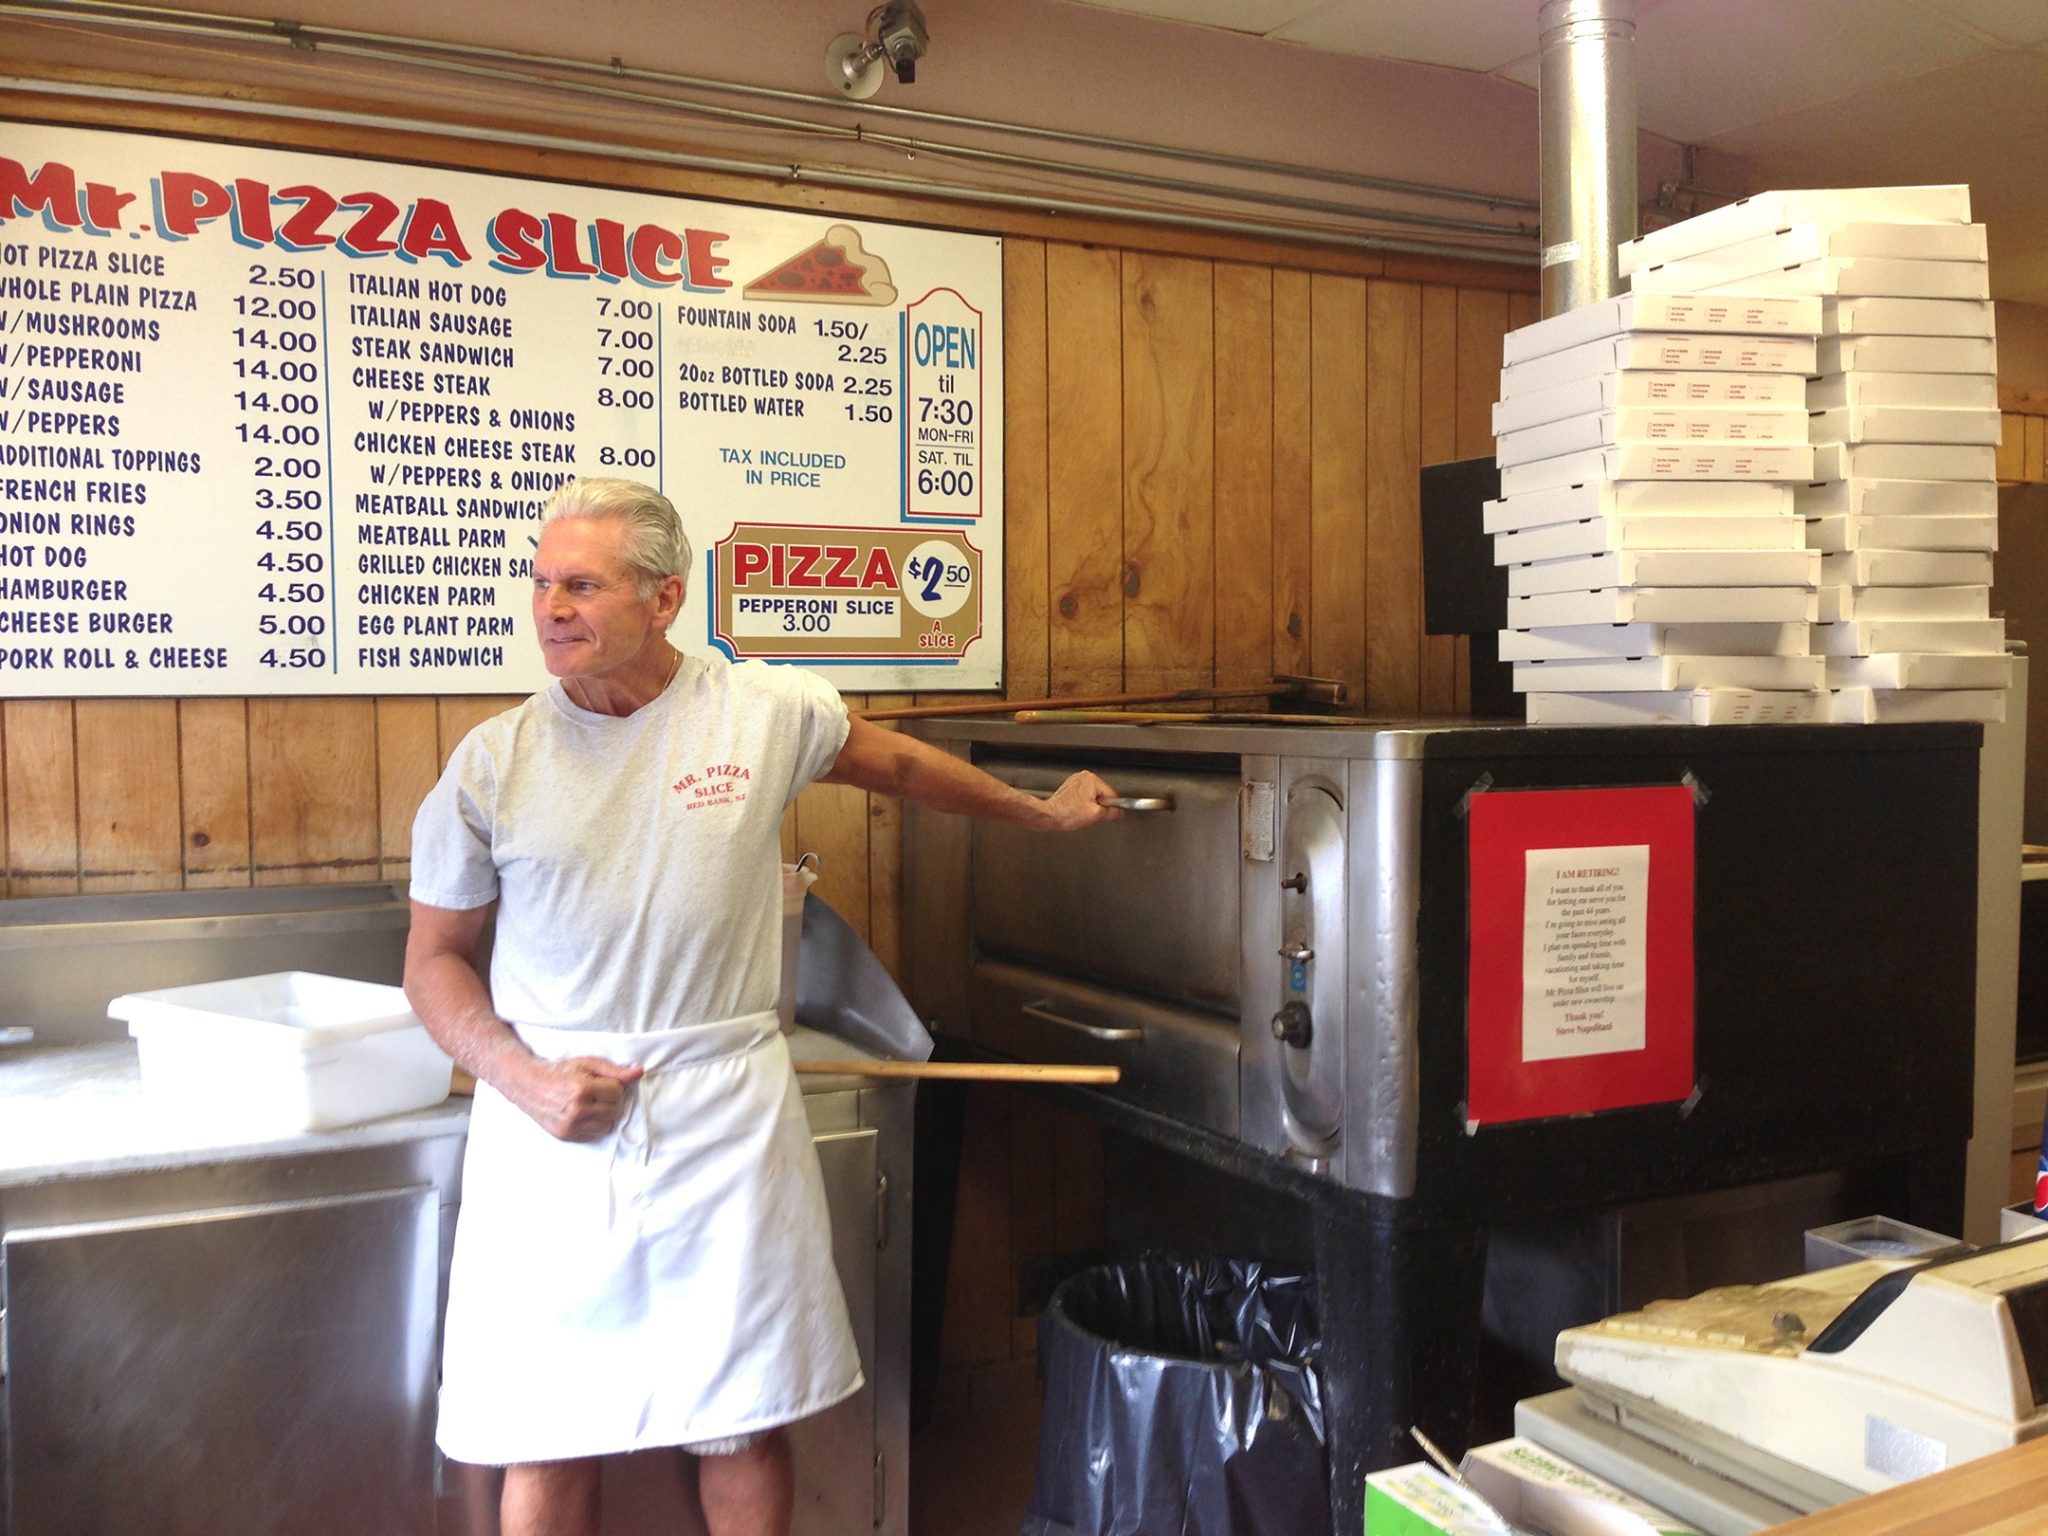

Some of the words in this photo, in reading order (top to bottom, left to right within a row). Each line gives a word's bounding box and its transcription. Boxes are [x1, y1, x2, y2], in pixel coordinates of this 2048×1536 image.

[0, 157, 151, 236] Mr.
[150, 172, 471, 268] PIZZA
[486, 207, 733, 294] SLICE
[0, 242, 30, 266] OT
[38, 246, 98, 272] PIZZA
[108, 252, 164, 276] SLICE
[248, 264, 316, 290] 2.50
[72, 282, 128, 308] PLAIN
[140, 286, 198, 312] PIZZA
[234, 296, 316, 320] 12.00
[350, 272, 420, 300] ITALIAN
[428, 280, 462, 304] HOT
[472, 284, 506, 308] DOG
[596, 298, 652, 320] 7.00
[350, 304, 420, 330] ITALIAN
[430, 312, 512, 338] SAUSAGE
[596, 328, 654, 350] 7.00
[678, 306, 750, 330] FOUNTAIN
[758, 314, 796, 334] SODA
[232, 328, 316, 352] 14.00
[914, 322, 974, 370] OPEN
[352, 336, 412, 360] STEAK
[420, 342, 514, 368] SANDWICH
[598, 356, 654, 378] 7.00
[838, 344, 888, 364] 2.25
[232, 358, 318, 382] 14.00
[680, 362, 714, 384] 20oz
[722, 366, 788, 388] BOTTLED
[794, 372, 834, 392] SODA
[844, 376, 892, 396] 2.25
[352, 366, 424, 392] CHEESE
[434, 372, 490, 396] STEAK
[598, 388, 654, 410] 8.00
[938, 374, 954, 394] til
[234, 390, 318, 414] 14.00
[680, 390, 748, 414] BOTTLED
[754, 396, 804, 418] WATER
[844, 404, 892, 424] 1.50
[918, 396, 974, 426] 7:30
[368, 400, 480, 426] W/PEPPERS
[488, 408, 502, 428] &
[510, 408, 574, 432] ONIONS
[234, 422, 320, 446] 14.00
[918, 428, 974, 444] MON-FRI
[354, 432, 436, 456] CHICKEN
[444, 436, 512, 460] CHEESE
[522, 442, 576, 464] STEAK
[600, 446, 656, 468] 8.00
[720, 448, 752, 464] TAX
[760, 450, 846, 468] INCLUDED
[918, 450, 947, 466] SAT.
[952, 452, 974, 466] TIL
[112, 448, 200, 474] TOPPINGS
[254, 456, 320, 478] 2.00
[370, 464, 482, 488] W/PEPPERS
[490, 470, 502, 490] &
[746, 470, 762, 484] IN
[770, 470, 820, 488] PRICE
[918, 468, 974, 496] 6:00
[0, 478, 76, 502] RENCH
[86, 482, 146, 504] FRIES
[256, 488, 322, 510] 3.50
[356, 492, 448, 516] MEATBALL
[70, 514, 134, 536] RINGS
[256, 520, 322, 542] 4.50
[358, 524, 450, 548] MEATBALL
[458, 528, 506, 548] PARM
[44, 546, 86, 568] DOG
[256, 552, 324, 572] 4.50
[358, 554, 426, 576] GRILLED
[432, 556, 502, 578] CHICKEN
[734, 544, 898, 590] PIZZA
[258, 582, 324, 602] 4.50
[358, 584, 438, 606] CHICKEN
[448, 586, 496, 606] PARM
[740, 598, 838, 614] PEPPERONI
[846, 600, 894, 614] SLICE
[0, 610, 78, 634] CHEESE
[88, 612, 172, 634] BURGER
[258, 614, 326, 636] 5.00
[358, 614, 394, 636] EGG
[404, 616, 460, 636] PLANT
[466, 616, 514, 636] PARM
[782, 614, 830, 632] 3.00
[933, 620, 941, 633] A
[920, 634, 954, 648] SLICE
[64, 648, 116, 670] ROLL
[124, 650, 140, 670] &
[150, 646, 228, 668] CHEESE
[260, 648, 326, 668] 4.50
[358, 646, 400, 668] FISH
[410, 646, 502, 668] SANDWICH
[673, 774, 702, 794] MR.
[706, 764, 750, 780] PIZZA
[694, 782, 734, 798] SLICE
[687, 801, 704, 810] RED
[1562, 870, 1575, 879] AM
[1565, 1012, 1587, 1022] Thank
